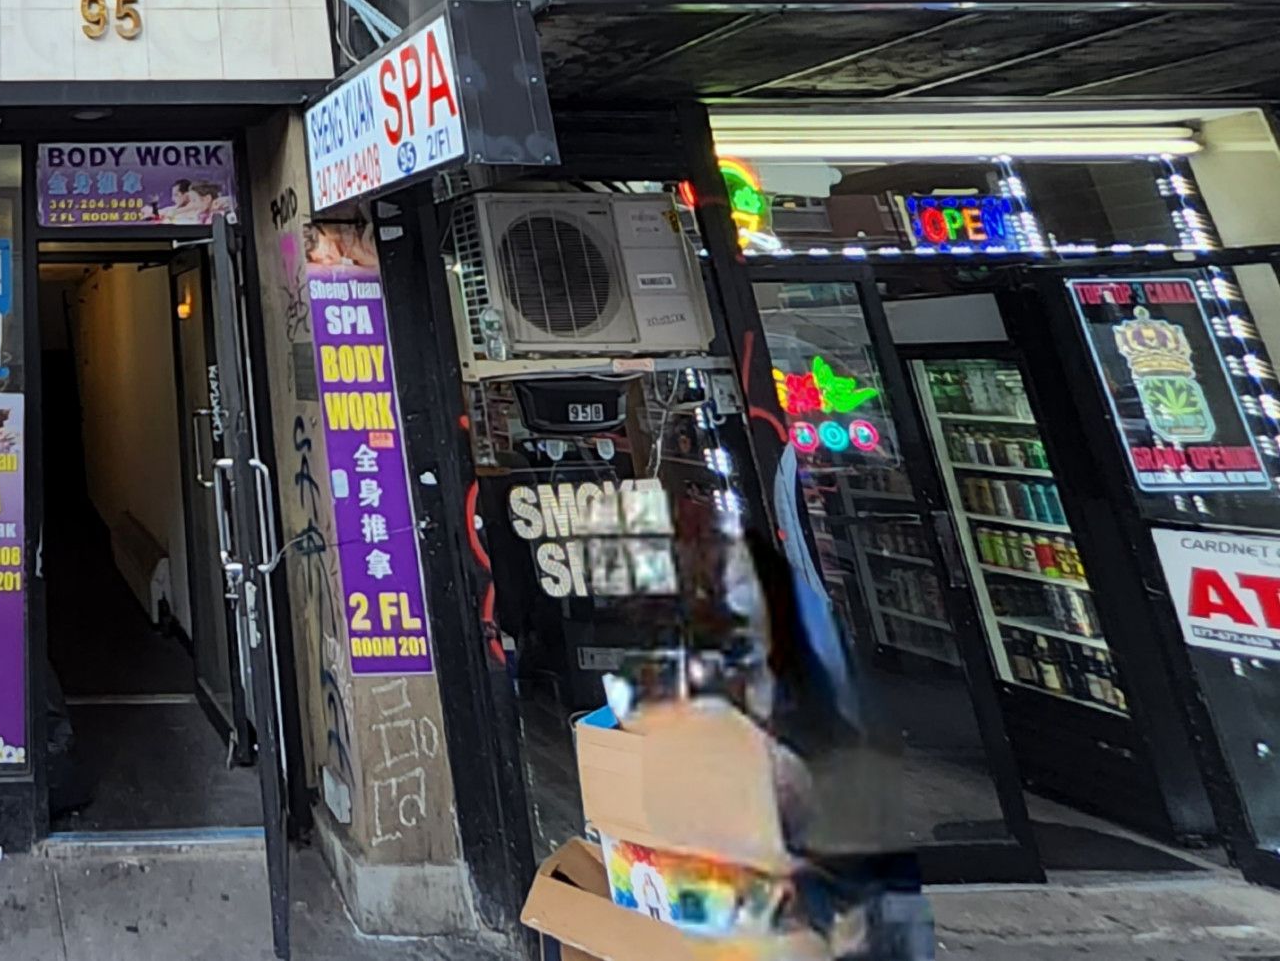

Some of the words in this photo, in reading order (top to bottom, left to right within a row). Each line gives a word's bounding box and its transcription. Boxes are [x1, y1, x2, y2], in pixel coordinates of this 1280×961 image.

[378, 29, 458, 147] SPA
[342, 75, 376, 140] YUAN
[47, 146, 126, 168] BODY
[136, 144, 225, 167] WORK
[399, 143, 417, 170] 95
[49, 212, 58, 223] 2
[60, 212, 76, 222] FL
[81, 212, 120, 222] ROOM
[122, 212, 145, 222] 201
[920, 205, 1007, 244] OPEN
[310, 278, 349, 303] Sheng
[349, 279, 381, 300] Yuan
[325, 304, 374, 336] SPA
[320, 344, 386, 385] BODY
[324, 391, 396, 432] WORK
[353, 443, 392, 580] 全身推拿
[1180, 537, 1270, 558] CARDNET
[349, 592, 372, 631] 2
[379, 591, 421, 631] FL
[351, 636, 397, 657] ROOM
[399, 636, 427, 657] 201
